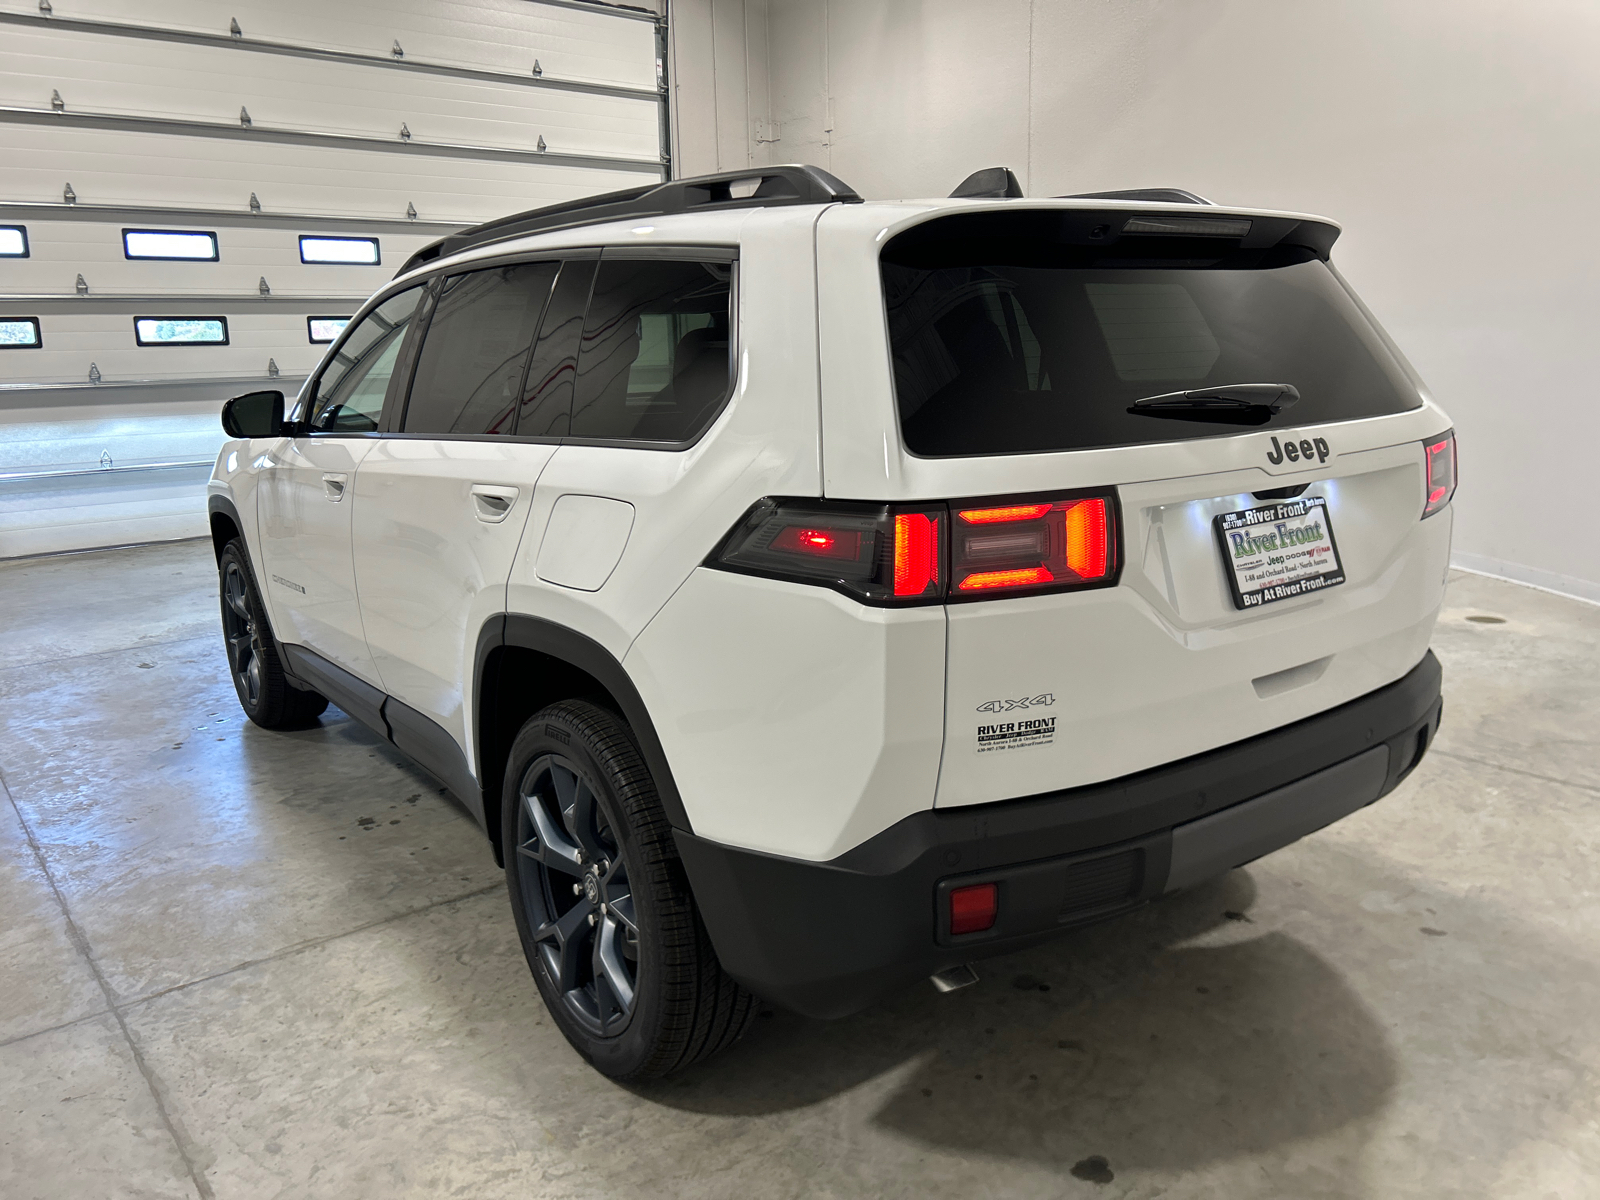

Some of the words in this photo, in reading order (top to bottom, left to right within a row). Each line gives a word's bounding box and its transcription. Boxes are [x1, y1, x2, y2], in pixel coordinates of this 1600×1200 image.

[1267, 436, 1330, 465] Jeep
[1245, 509, 1275, 525] River
[1277, 502, 1306, 519] Front
[1230, 529, 1278, 559] River
[1274, 521, 1324, 549] Front
[1244, 574, 1256, 583] I-88
[1256, 571, 1266, 580] and
[1265, 567, 1285, 578] Orchard
[1285, 563, 1297, 573] Road
[1299, 560, 1313, 570] North
[1313, 558, 1328, 567] Aurora
[1267, 555, 1285, 566] Jeep
[1242, 591, 1263, 606] Buy
[1263, 588, 1275, 601] At
[1276, 583, 1301, 598] River
[976, 692, 1056, 713] 4x4
[545, 724, 571, 746] PIRELLI
[978, 723, 1015, 735] RIVER
[1018, 717, 1056, 730] FRONT
